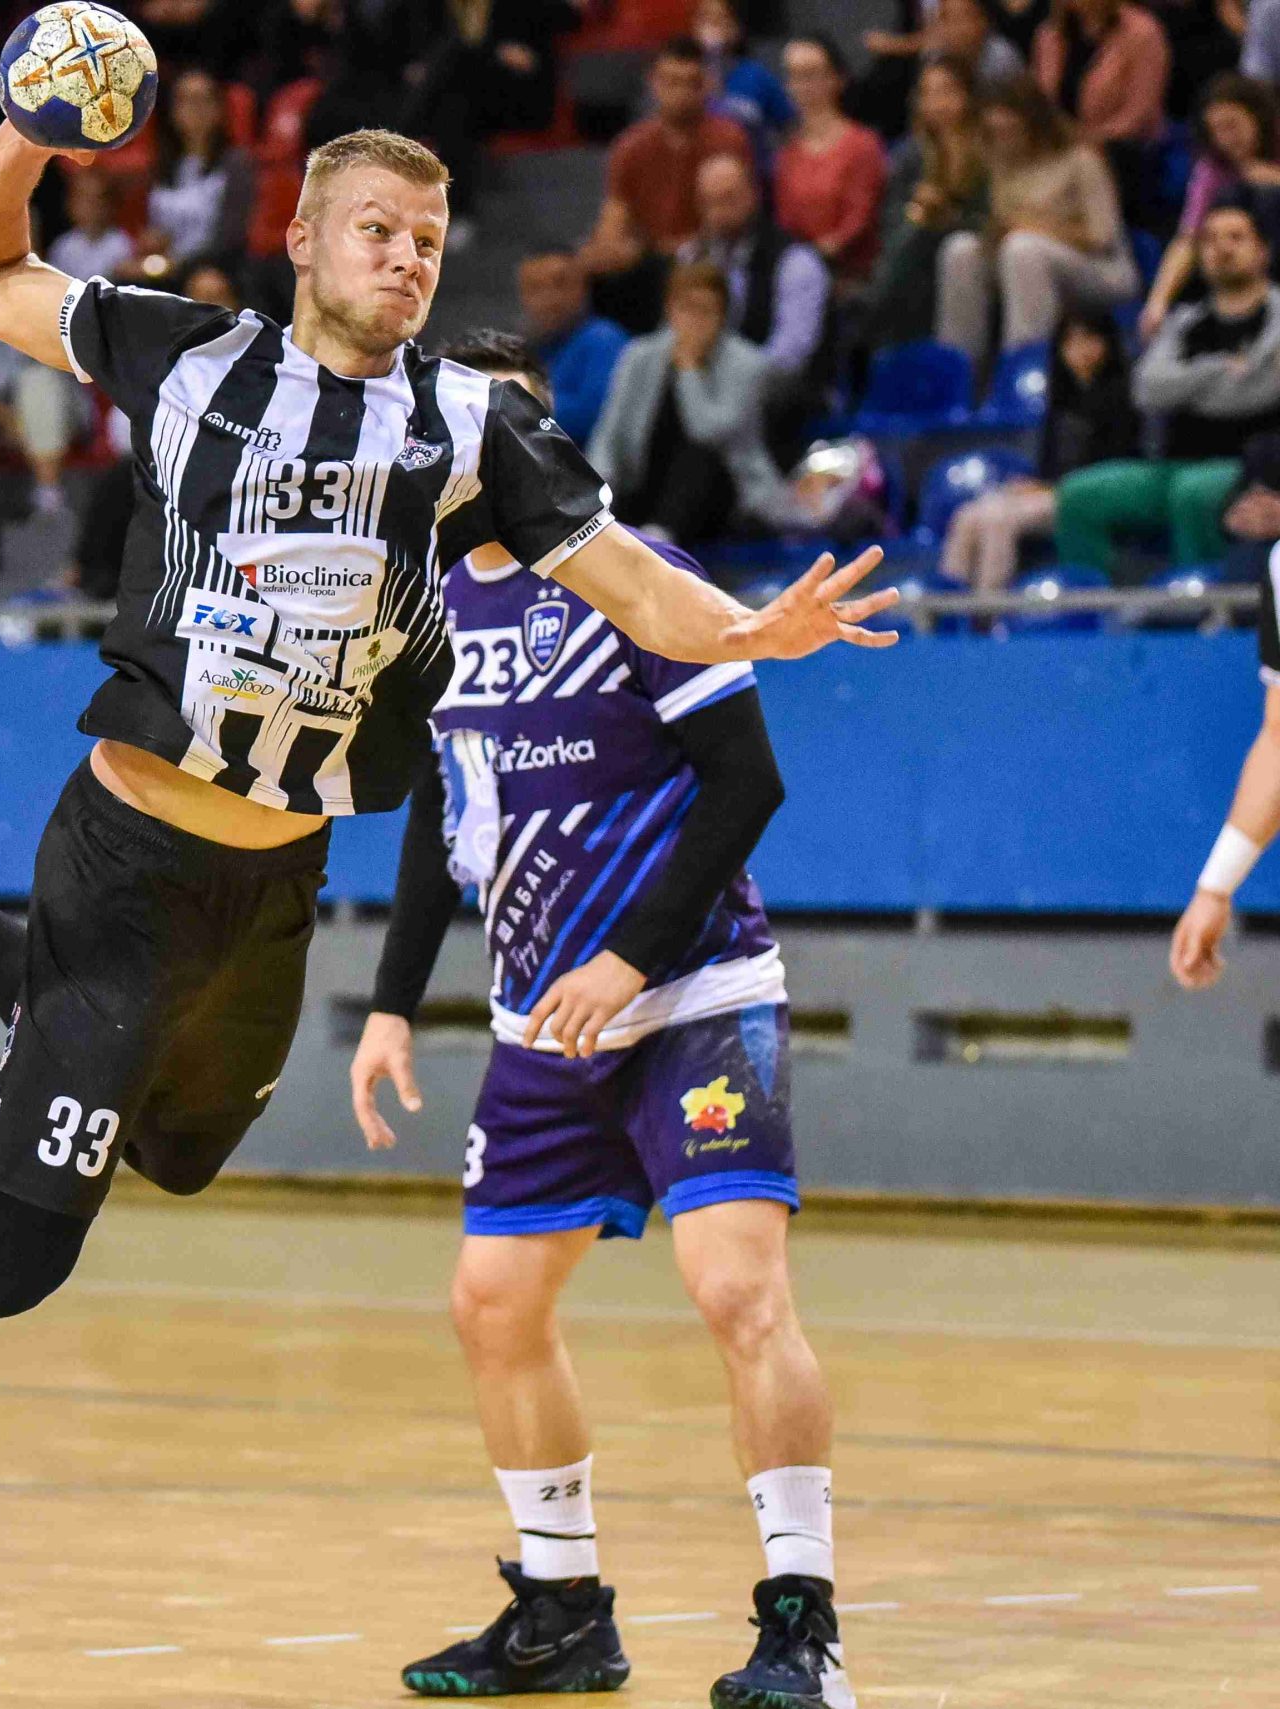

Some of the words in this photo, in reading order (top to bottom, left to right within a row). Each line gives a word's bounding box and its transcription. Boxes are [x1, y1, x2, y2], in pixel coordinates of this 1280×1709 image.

[60, 305, 69, 337] unit
[265, 459, 352, 520] 33
[577, 518, 602, 541] unit
[263, 564, 373, 587] Bioclinica
[263, 585, 300, 596] zdravlje
[308, 586, 336, 597] lepota
[459, 639, 517, 694] 23
[38, 1095, 120, 1177] 33
[462, 1123, 487, 1188] 3
[540, 1479, 582, 1502] 23
